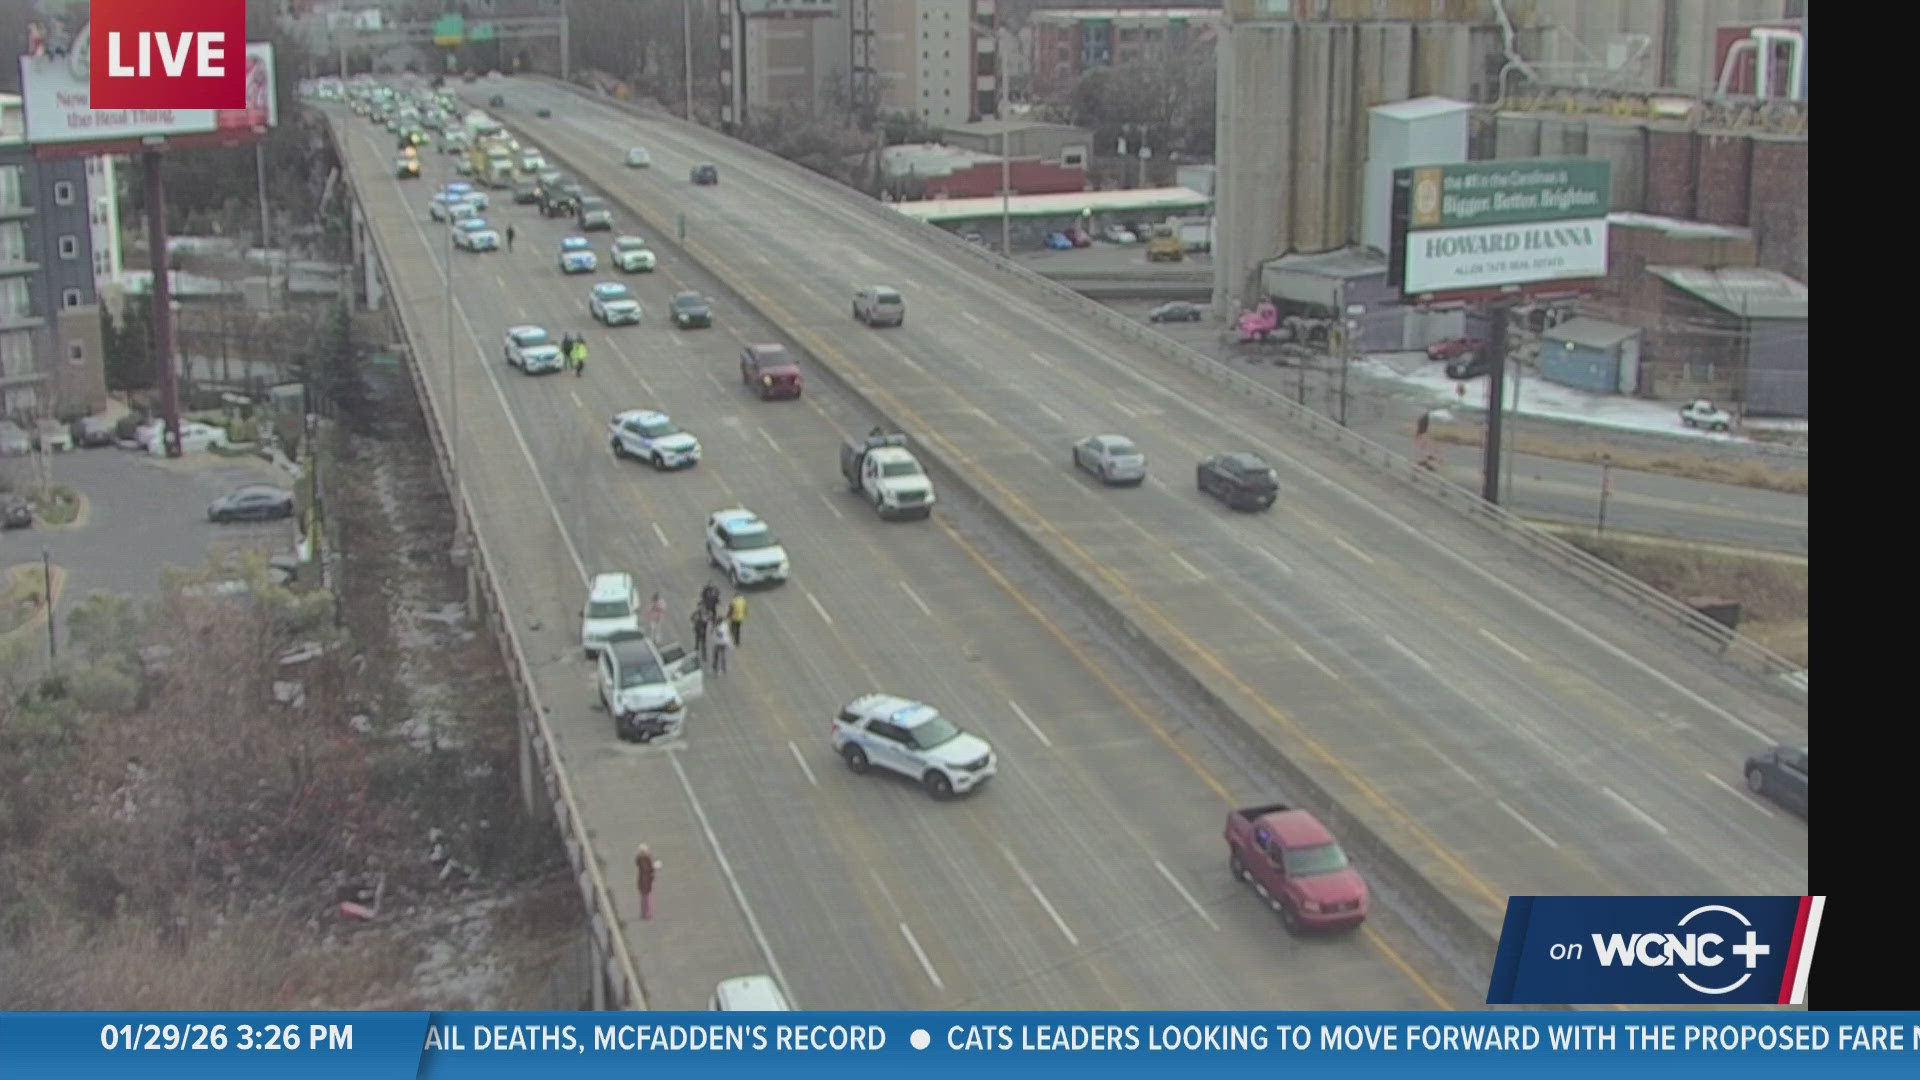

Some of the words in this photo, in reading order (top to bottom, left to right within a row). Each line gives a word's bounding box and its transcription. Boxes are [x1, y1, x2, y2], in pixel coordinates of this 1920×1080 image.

[1541, 186, 1599, 211] Brighter.
[1425, 231, 1520, 258] HOWARD
[1524, 226, 1592, 250] HANNA
